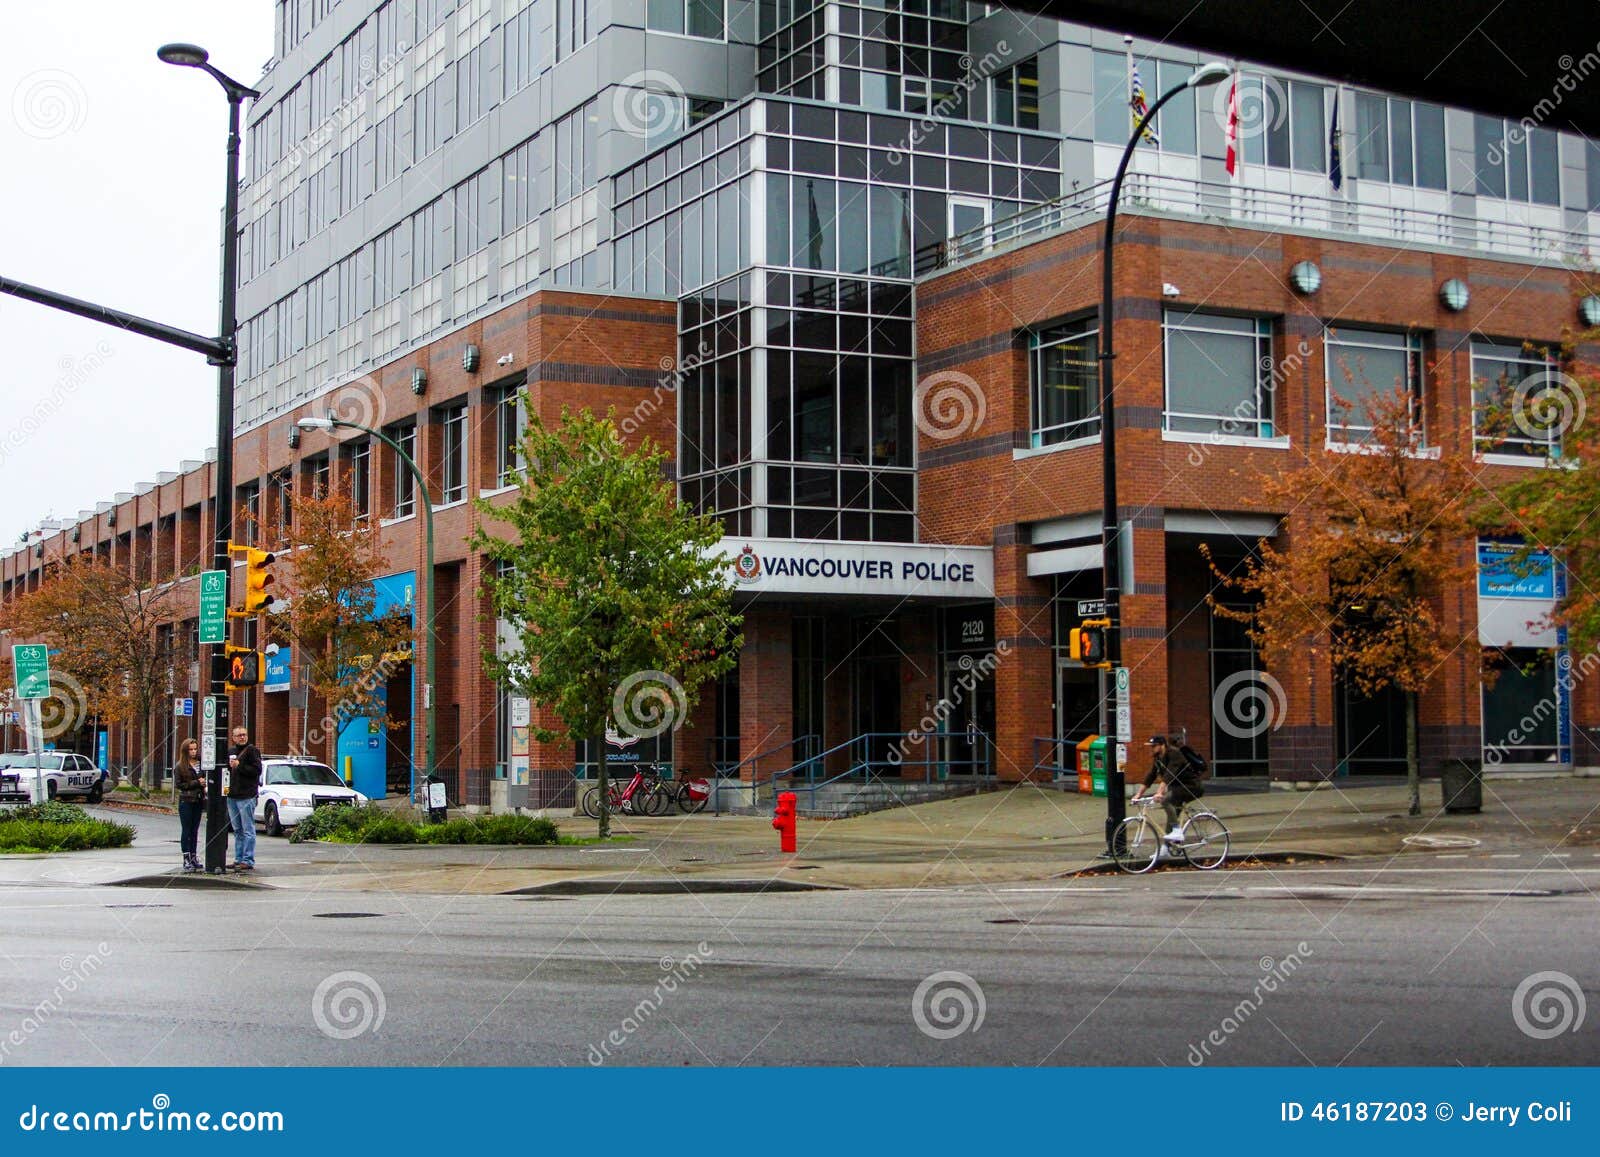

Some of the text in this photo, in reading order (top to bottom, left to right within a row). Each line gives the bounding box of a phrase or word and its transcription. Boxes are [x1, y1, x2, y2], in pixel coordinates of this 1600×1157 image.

[762, 556, 893, 579] VANCOUVER
[902, 561, 975, 583] POLICE
[1528, 584, 1545, 593] Call
[962, 619, 984, 636] 2120
[67, 775, 93, 786] POLICE
